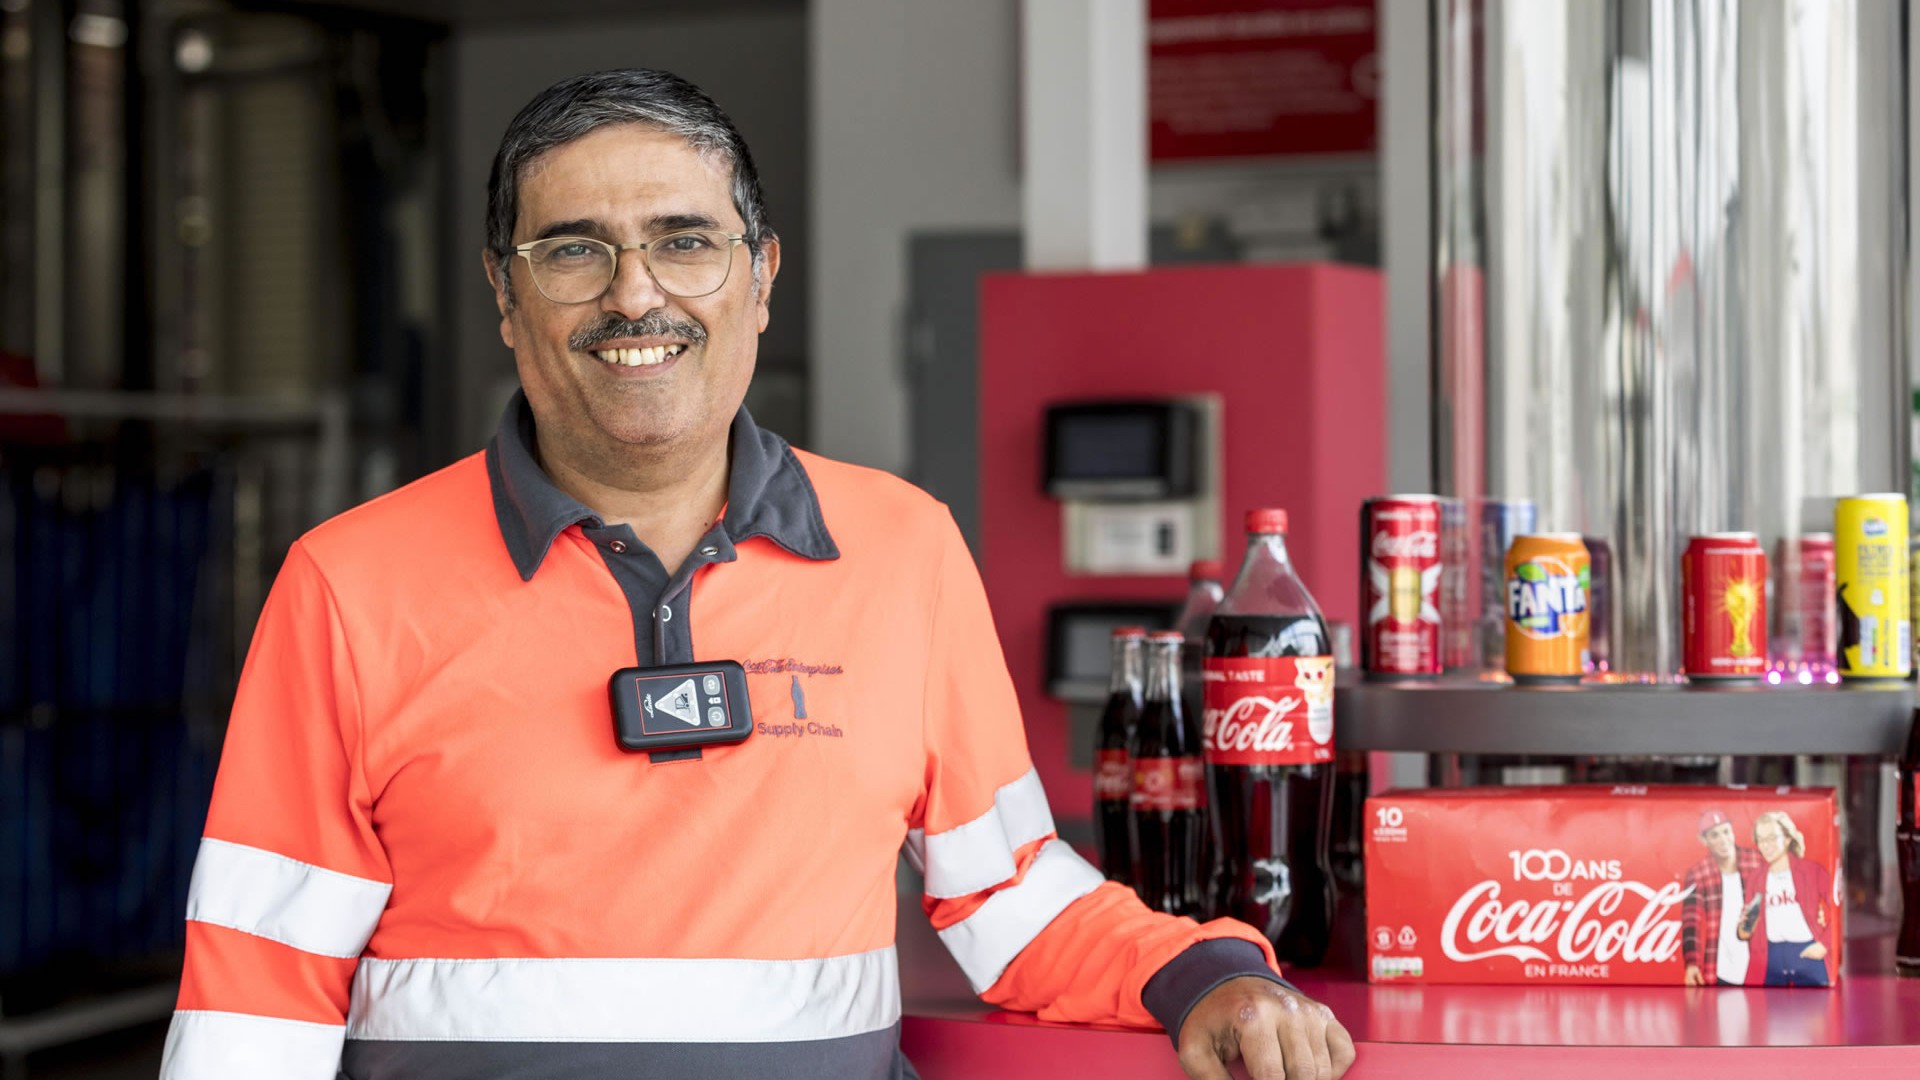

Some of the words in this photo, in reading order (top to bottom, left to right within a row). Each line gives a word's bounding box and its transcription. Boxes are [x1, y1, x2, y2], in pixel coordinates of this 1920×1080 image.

[1508, 574, 1587, 622] FANTA
[757, 722, 804, 737] Supply
[807, 721, 843, 738] Chain
[1375, 806, 1403, 827] 10
[1553, 883, 1573, 896] DE
[1440, 880, 1697, 962] Coca-Cola
[1525, 964, 1546, 978] EN
[1549, 963, 1609, 978] FRANCE
